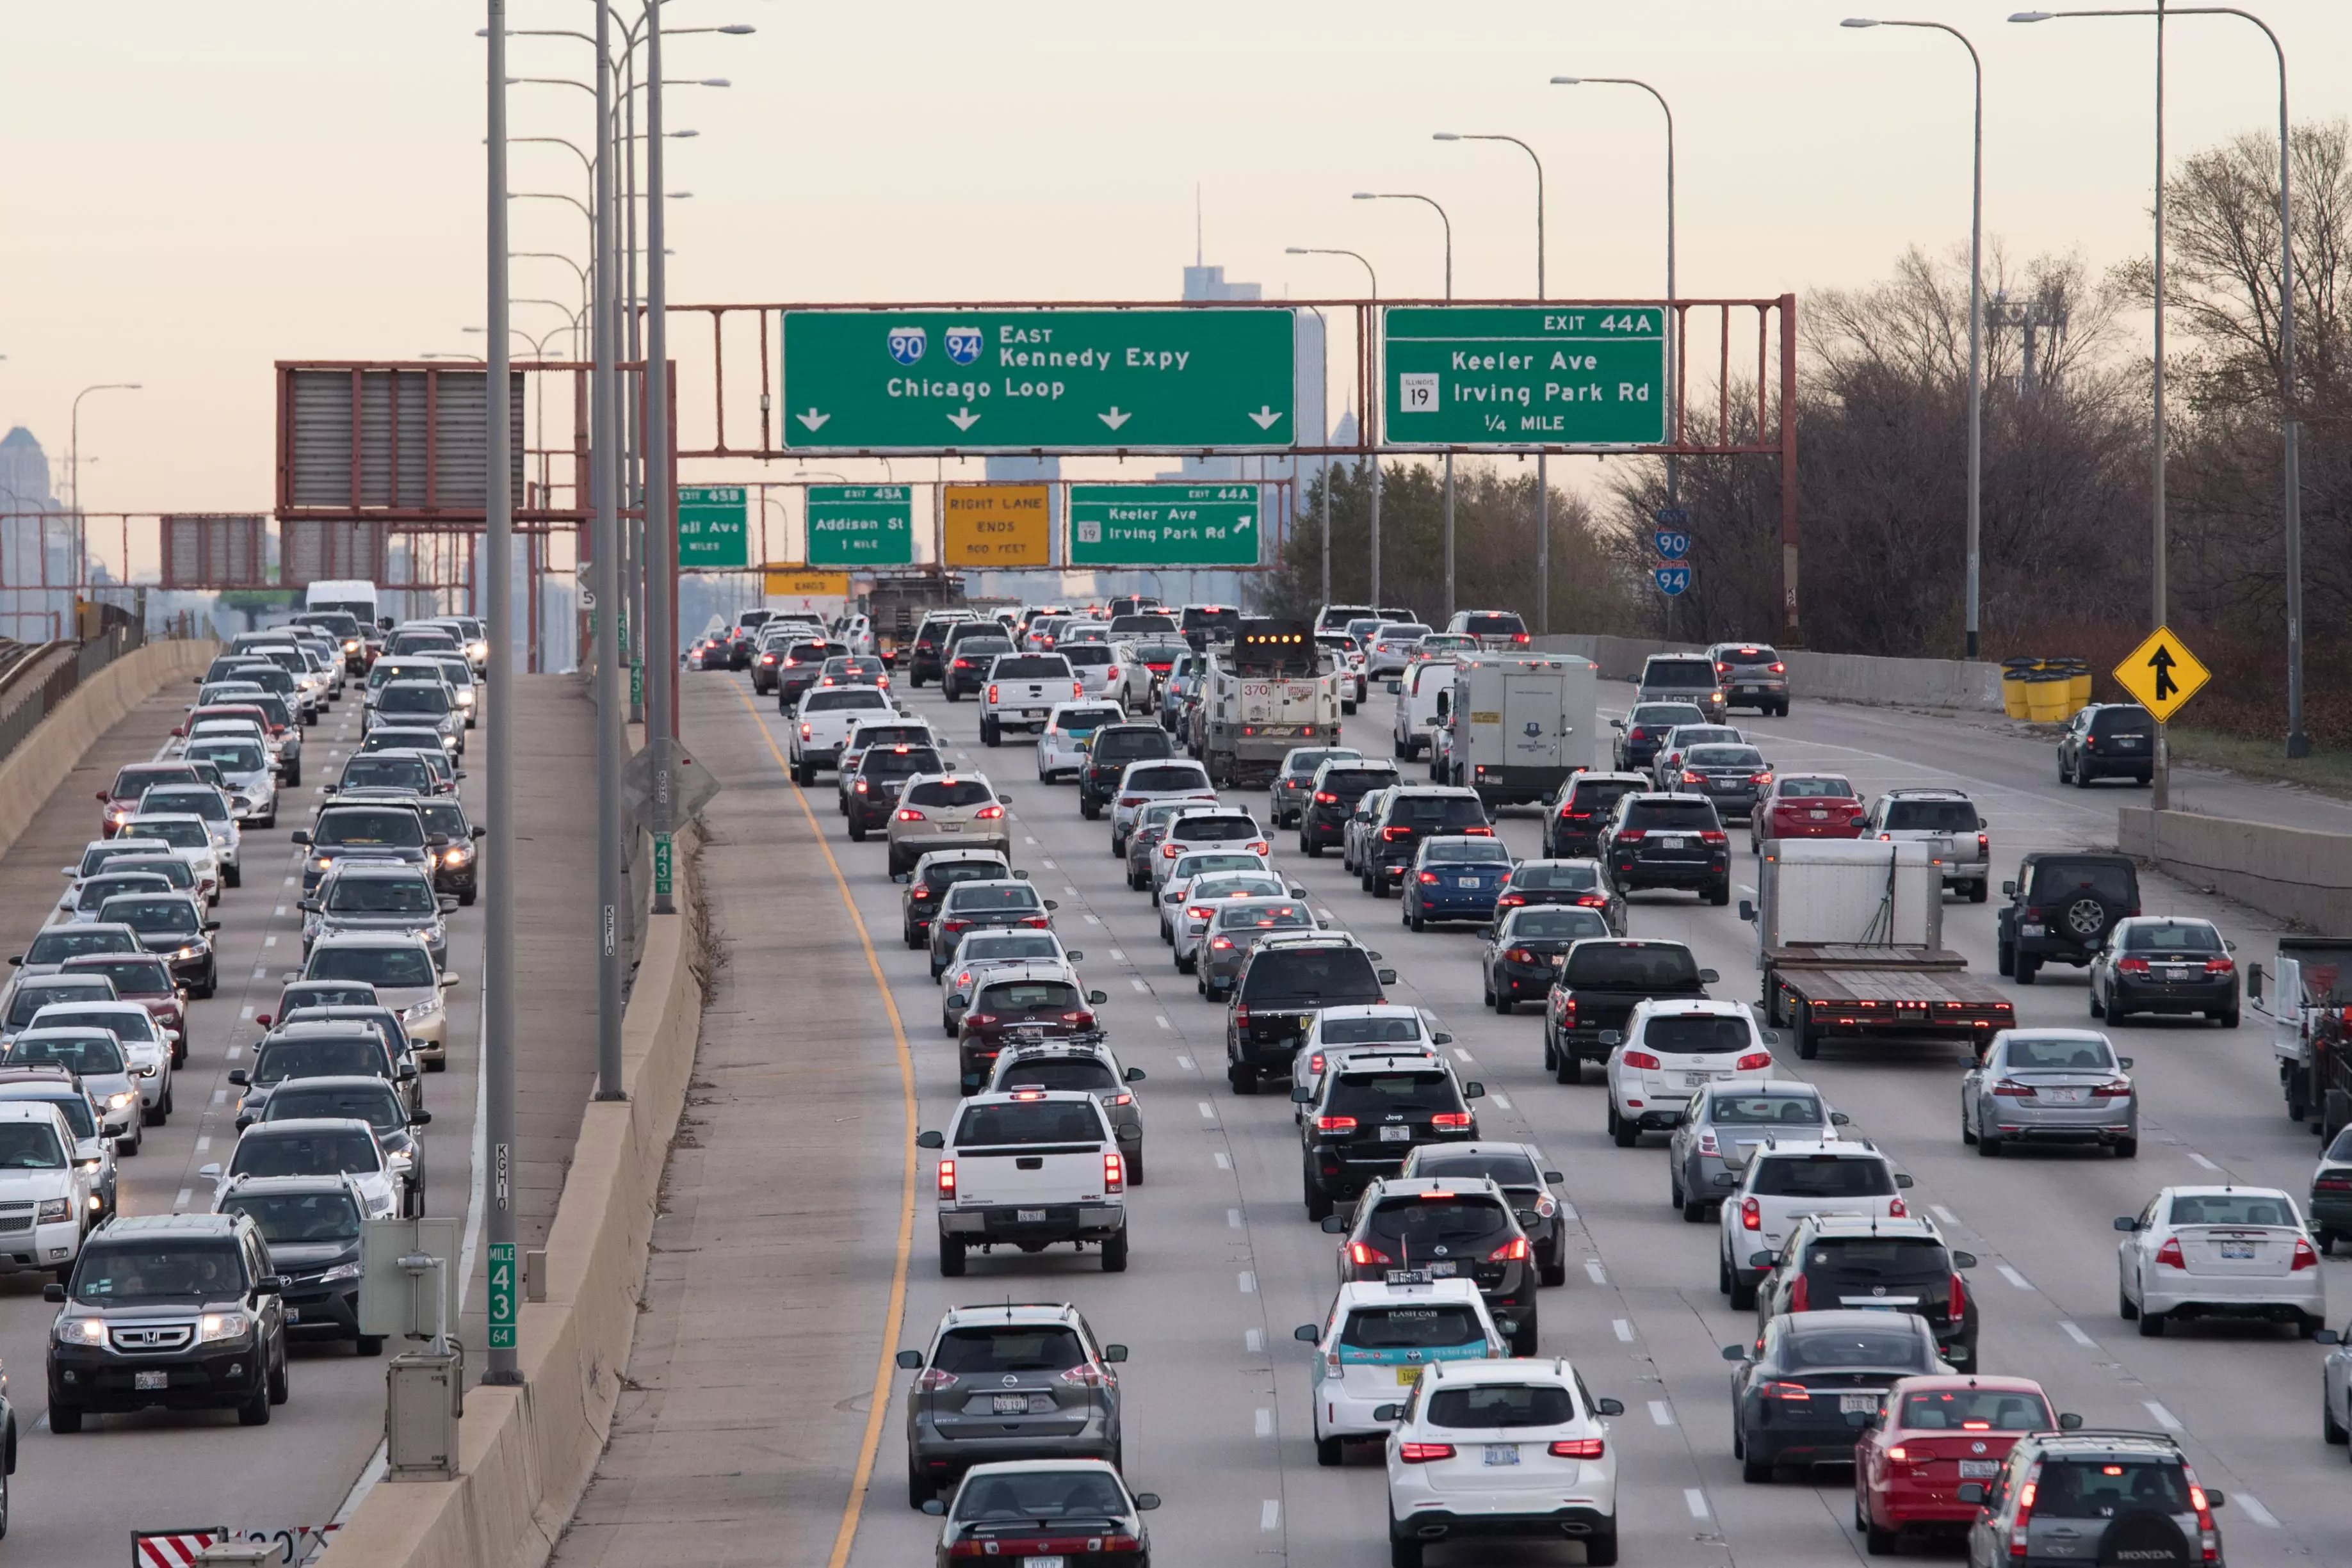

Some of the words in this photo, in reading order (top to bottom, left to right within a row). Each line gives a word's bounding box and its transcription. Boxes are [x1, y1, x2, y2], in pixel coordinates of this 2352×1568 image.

[1544, 316, 1585, 331] EXIT
[1600, 316, 1652, 332] 44A
[1000, 325, 1053, 343] EAST
[891, 337, 923, 359] 90
[948, 336, 980, 358] 94
[1000, 348, 1112, 371] Kennedy
[1126, 348, 1190, 371] Expy
[1452, 352, 1534, 371] Keeler
[1550, 352, 1598, 370] Ave
[887, 378, 991, 402] Chicago
[1005, 377, 1066, 400] Loop
[1411, 388, 1429, 405] 19
[1454, 384, 1531, 408] Irving
[1545, 383, 1603, 403] Park
[1619, 383, 1650, 403] Rd
[1521, 416, 1565, 432] MILE
[843, 489, 867, 499] EXIT
[873, 487, 904, 499] 45A
[1188, 490, 1210, 499] EXIT
[1218, 489, 1250, 499] 44A
[950, 498, 994, 510] RIGHT
[1003, 498, 1043, 510] LANE
[1108, 508, 1158, 521] Keeler
[1167, 508, 1197, 521] Ave
[708, 522, 739, 533] Ave
[815, 518, 879, 531] Addison
[888, 517, 904, 530] St
[976, 522, 1016, 533] ENDS
[1083, 529, 1096, 540] 19
[1108, 526, 1156, 543] Irving
[1163, 526, 1199, 540] Park
[1205, 526, 1227, 540] Rd
[853, 539, 879, 549] MILE
[998, 543, 1027, 554] FEET
[1660, 535, 1685, 553] 90
[793, 581, 826, 592] ENDS
[1660, 572, 1685, 589] 94
[1244, 684, 1268, 696] 370
[657, 845, 669, 878] 43
[660, 883, 669, 891] 74
[489, 1247, 515, 1261] MILE
[491, 1265, 510, 1320] 43
[492, 1329, 509, 1343] 64
[2117, 1549, 2177, 1560] HONDA
